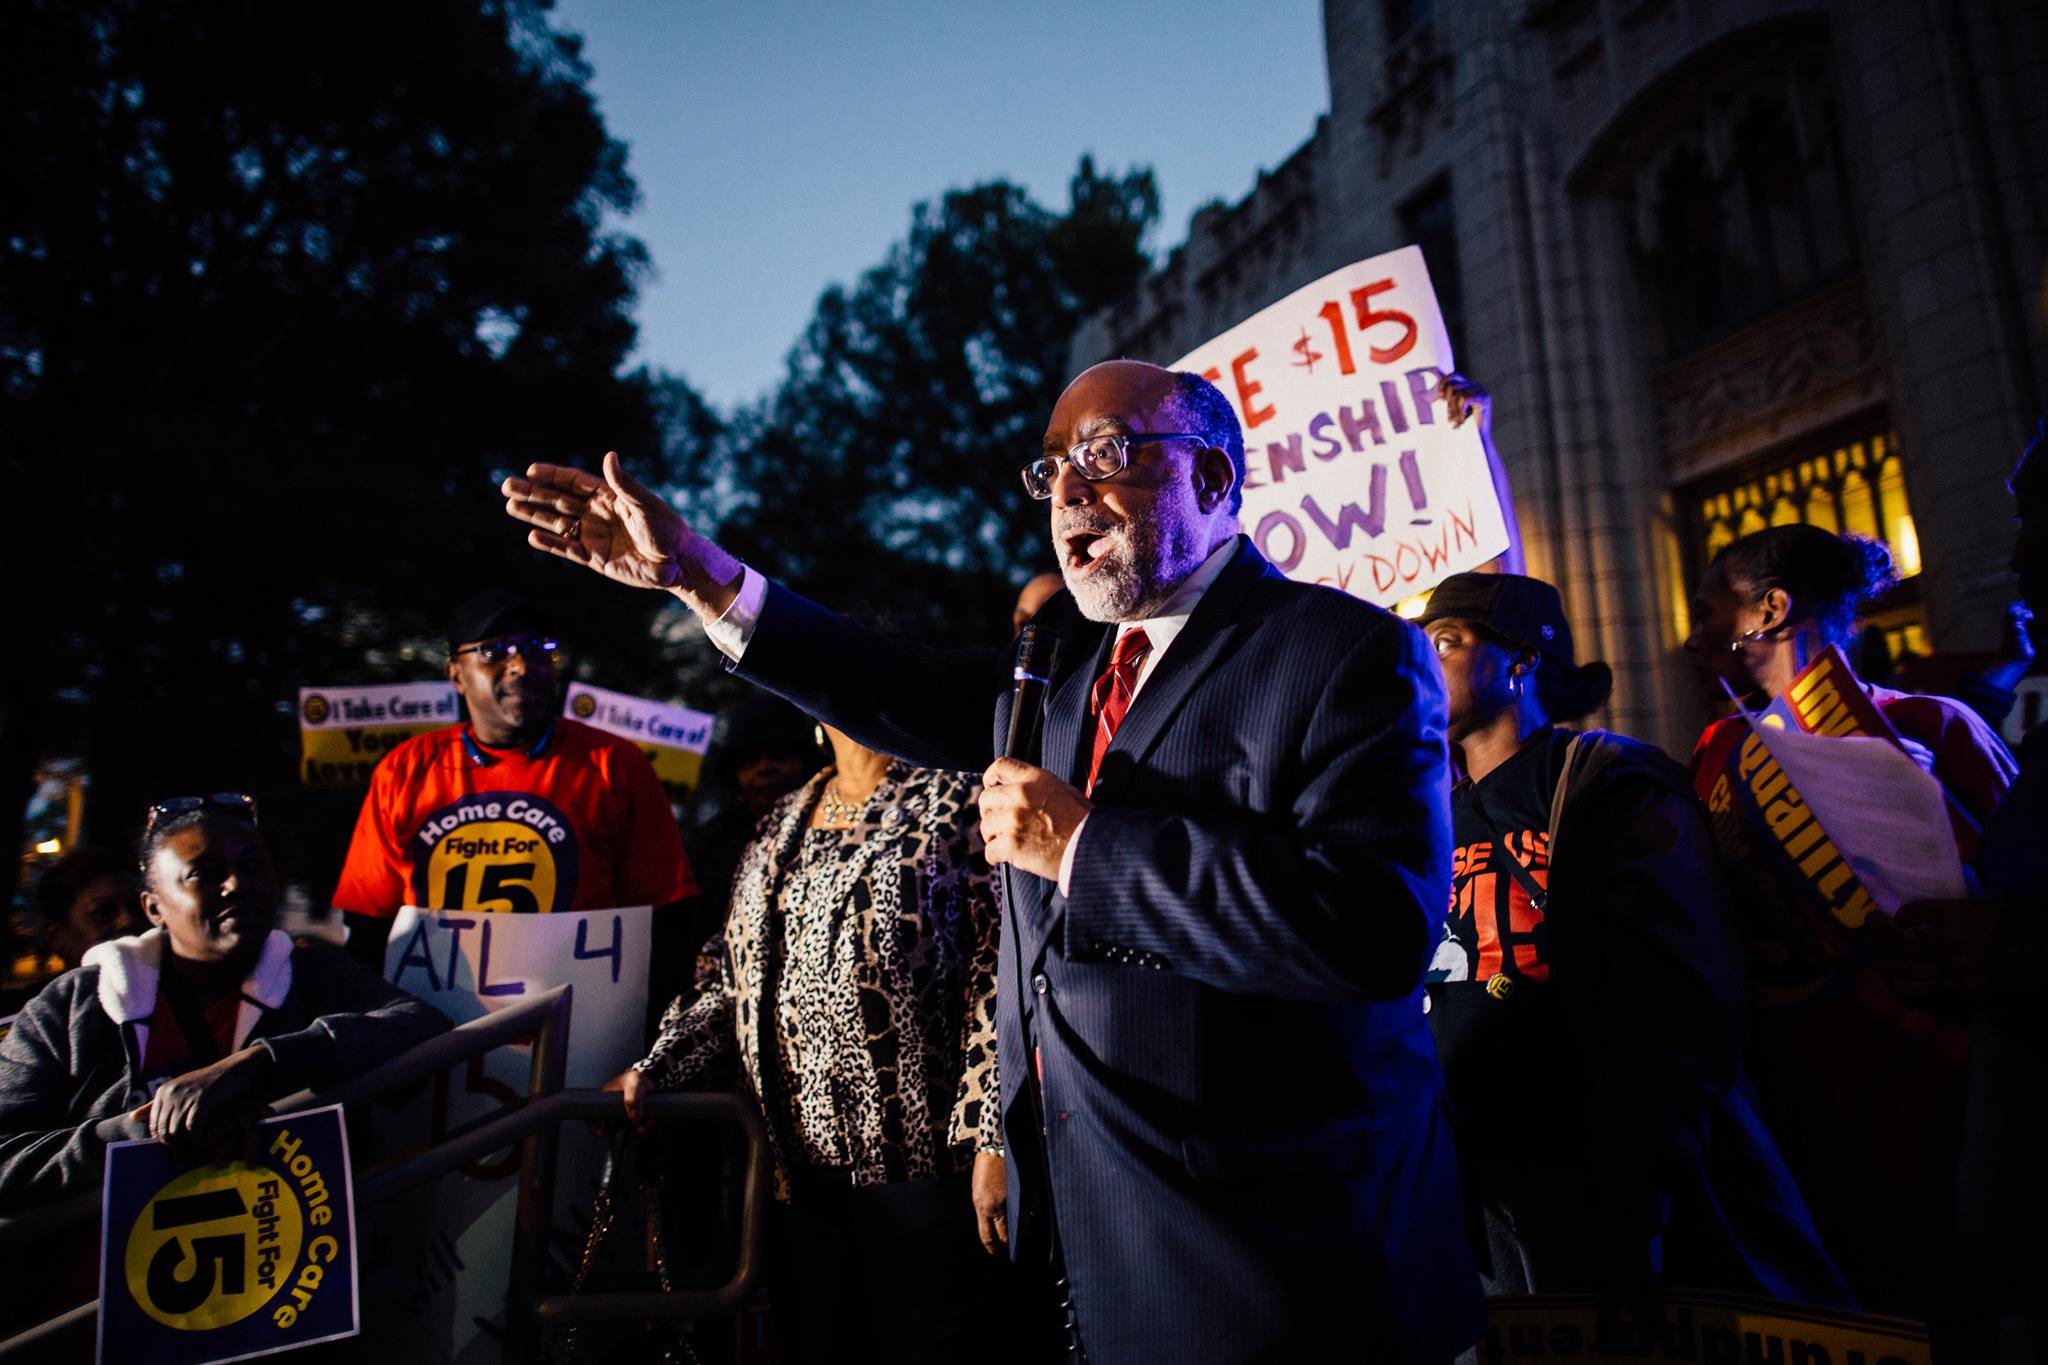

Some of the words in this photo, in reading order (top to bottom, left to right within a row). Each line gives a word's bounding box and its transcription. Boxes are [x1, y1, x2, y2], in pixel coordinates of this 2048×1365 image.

[1290, 278, 1419, 376] $15
[1365, 501, 1478, 593] DOWN
[343, 698, 384, 719] Take
[388, 697, 432, 719] Care
[436, 693, 454, 714] of
[647, 715, 684, 740] Care
[418, 802, 502, 846] Home
[506, 799, 567, 845] Care
[445, 837, 501, 858] Fight
[504, 838, 538, 853] For
[443, 862, 540, 913] 15
[393, 918, 525, 996] ATL
[574, 915, 623, 983] 4
[269, 1128, 334, 1228] Home
[252, 1179, 280, 1245] Fight
[146, 1187, 247, 1315] 15
[257, 1244, 280, 1289] For
[272, 1234, 339, 1329] Care
